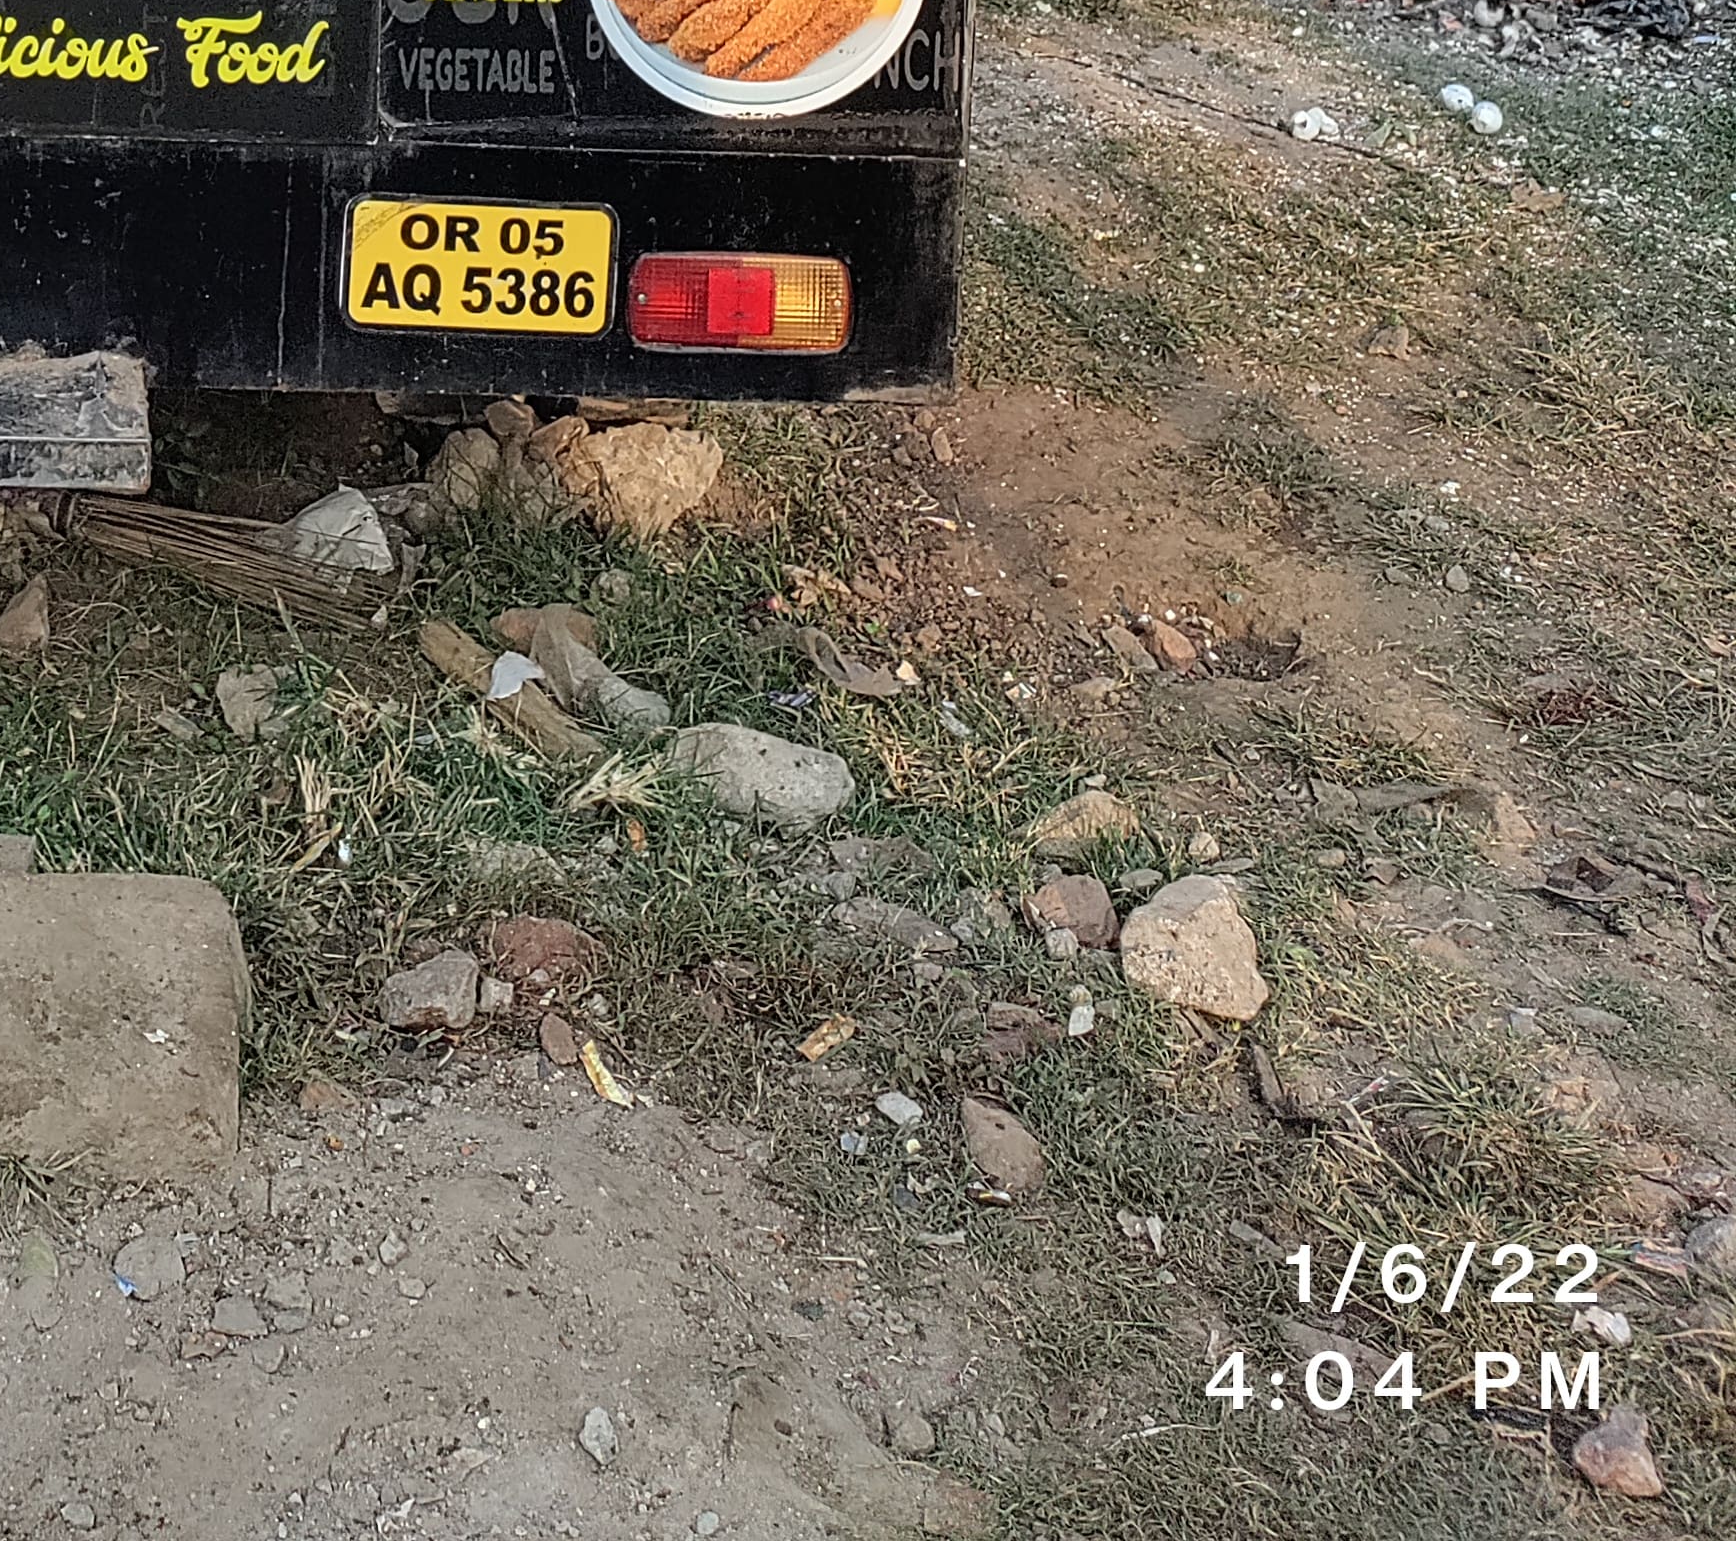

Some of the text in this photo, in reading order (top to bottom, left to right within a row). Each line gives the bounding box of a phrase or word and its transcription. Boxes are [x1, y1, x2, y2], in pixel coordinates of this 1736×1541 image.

[175, 11, 331, 90] Food
[397, 45, 557, 95] VEGETABLE
[399, 213, 567, 259] OR 05
[359, 262, 598, 320] AQ 5386
